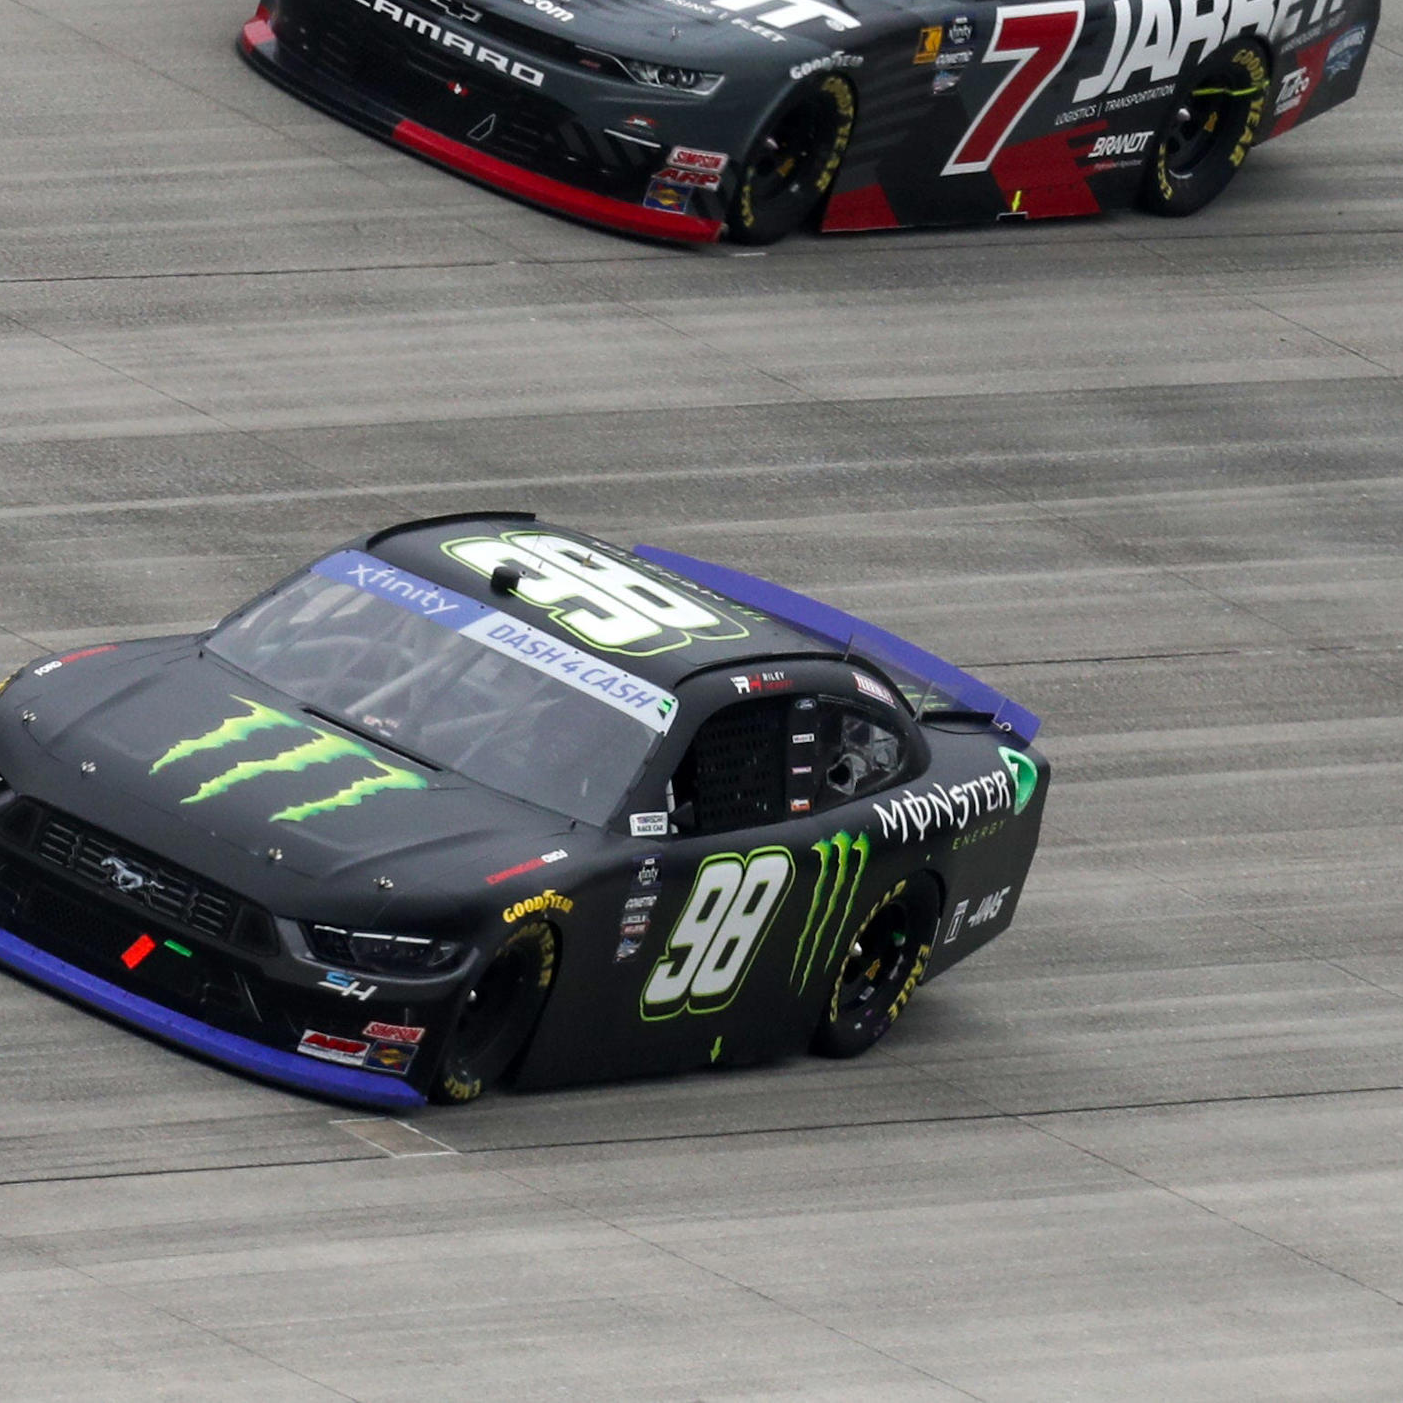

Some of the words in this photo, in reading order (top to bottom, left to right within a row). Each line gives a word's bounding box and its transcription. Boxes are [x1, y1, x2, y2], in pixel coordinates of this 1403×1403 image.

[940, 0, 1086, 176] 7
[1055, 104, 1098, 126] LOGISTICS
[1104, 82, 1177, 112] TRANSPORTATION
[673, 150, 722, 170] SIMPSON
[1087, 130, 1156, 159] BRANDT
[656, 167, 720, 186] ARP
[348, 563, 460, 615] xfinity
[487, 623, 559, 666] DASH
[560, 660, 583, 677] 4
[577, 667, 657, 710] CASH
[762, 671, 786, 682] RILEY
[872, 769, 1011, 844] MONSTER
[951, 819, 1007, 851] ENERGY
[502, 889, 575, 924] GOODYEAR
[640, 844, 797, 1022] 98
